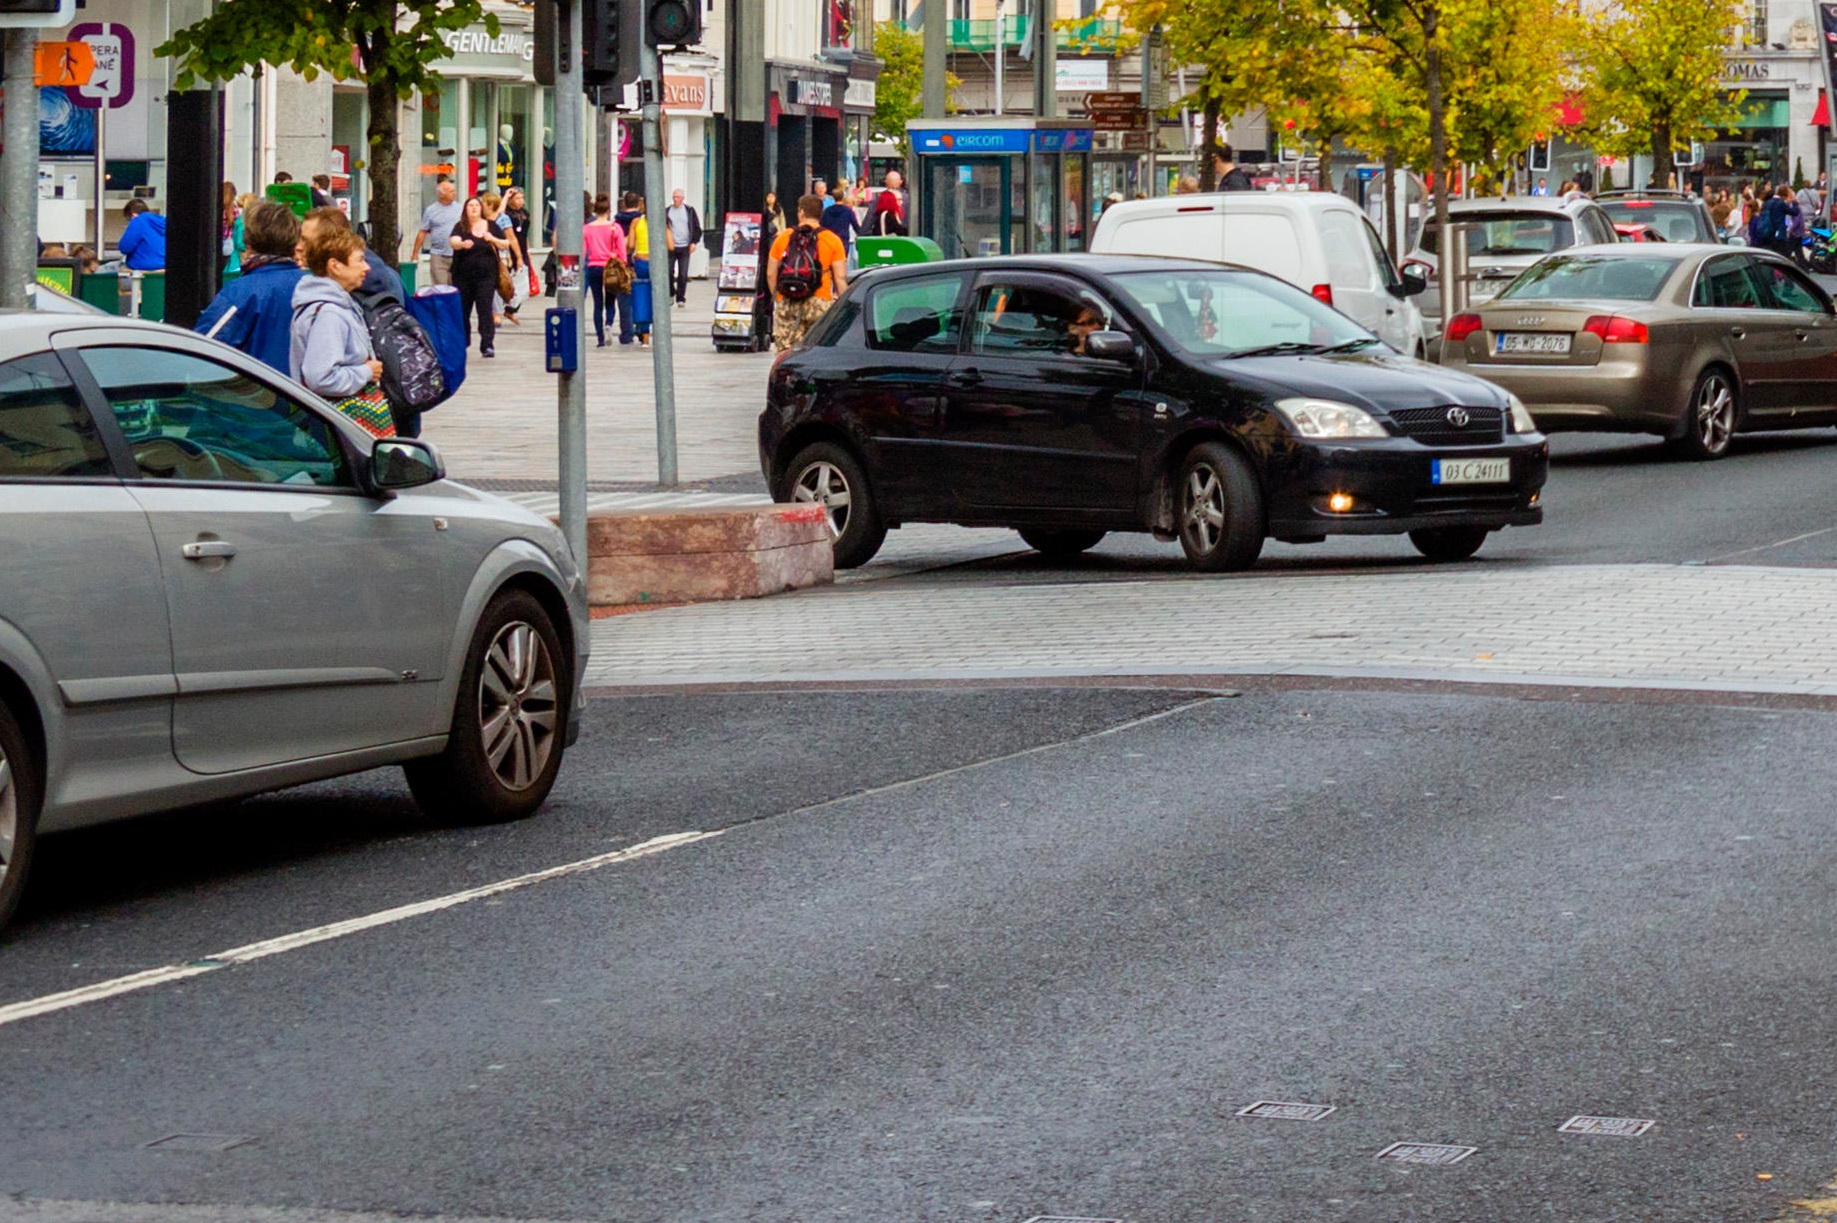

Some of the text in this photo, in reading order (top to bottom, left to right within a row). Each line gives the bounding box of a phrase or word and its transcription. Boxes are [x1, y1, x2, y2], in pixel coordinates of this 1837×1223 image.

[91, 45, 119, 56] PERA
[957, 134, 1004, 147] eircom
[1446, 465, 1461, 479] 03
[1463, 464, 1473, 479] C
